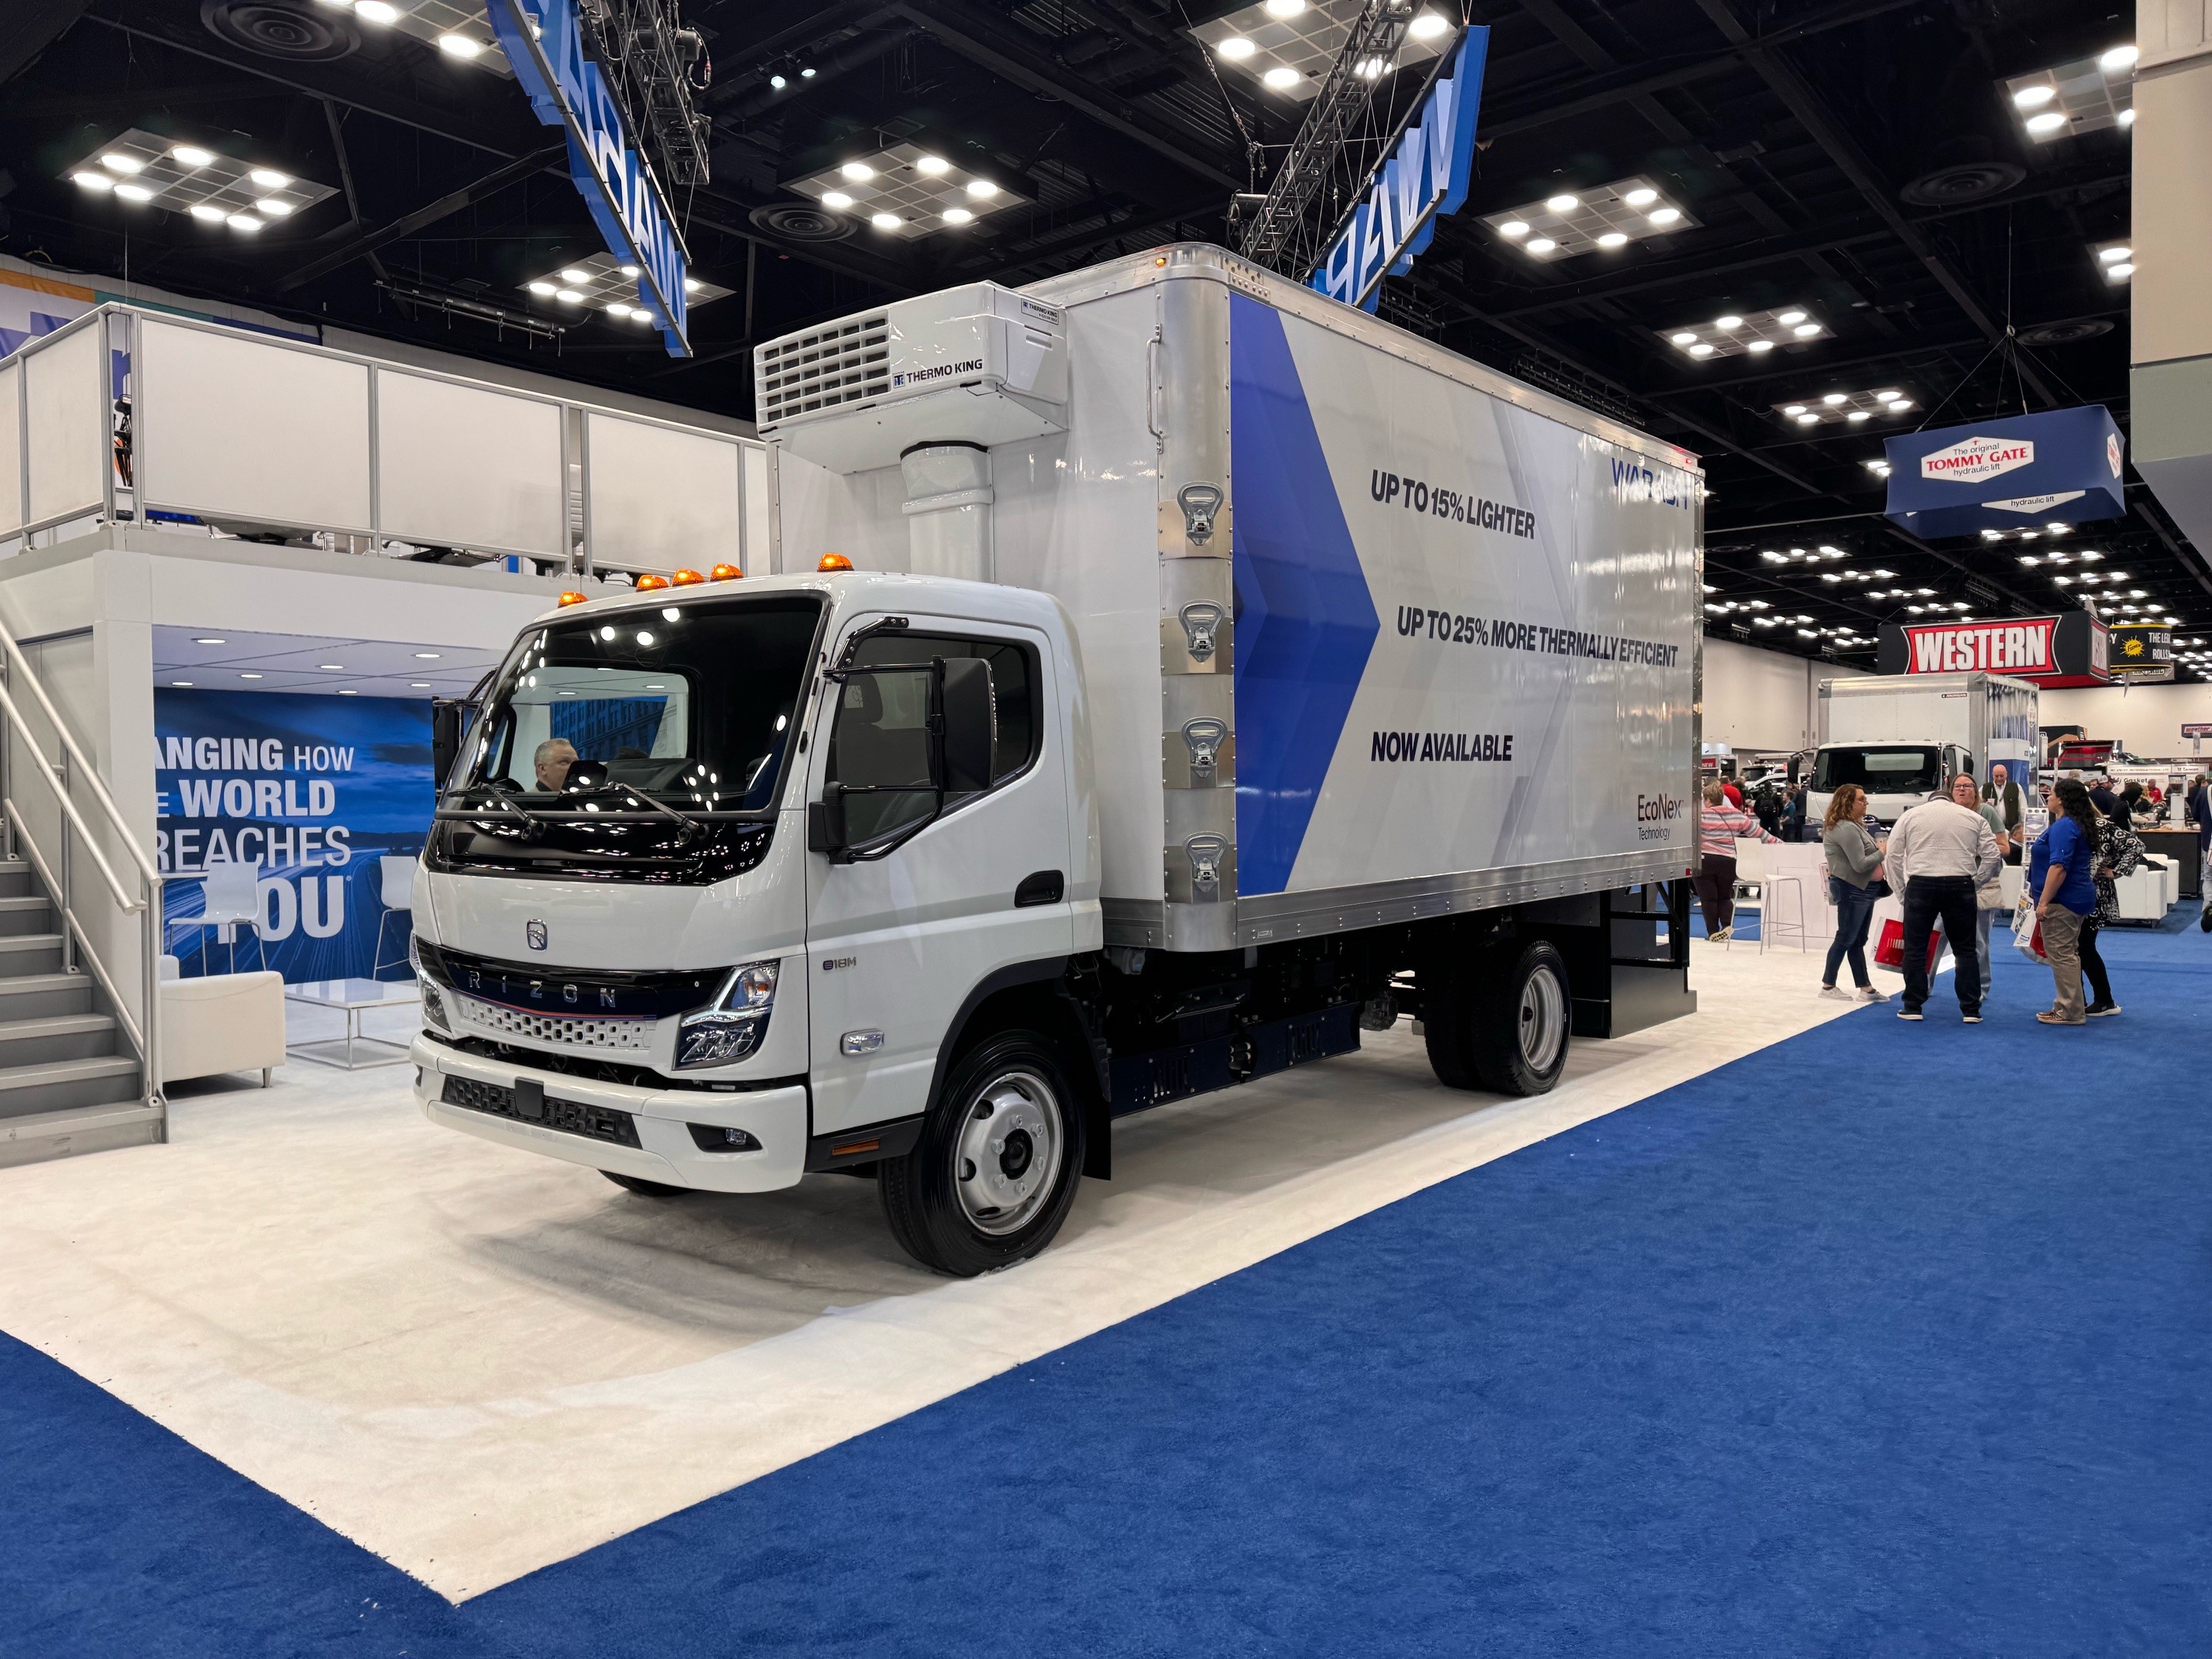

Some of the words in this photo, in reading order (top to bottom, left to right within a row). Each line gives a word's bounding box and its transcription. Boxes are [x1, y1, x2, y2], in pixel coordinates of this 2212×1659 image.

[1029, 303, 1046, 314] THERMO
[906, 365, 953, 383] THERMO
[955, 359, 983, 373] KING
[1927, 454, 1984, 472] TOMMY
[1990, 448, 2028, 462] GATE
[1970, 443, 2000, 453] original
[1953, 465, 1990, 476] hydraulic
[1372, 469, 1400, 503] UP
[1403, 477, 1428, 512] TO
[1431, 487, 1465, 522] 15%
[1467, 496, 1535, 539] LIGHTER
[2011, 496, 2045, 507] hydraulic
[1397, 605, 1424, 637] UP
[1427, 610, 1451, 641] TO
[1453, 615, 1488, 646] 25%
[1491, 620, 1537, 651] MORE
[1540, 627, 1618, 661] THERMALLY
[1619, 637, 1679, 668] EFFICIENT
[1915, 624, 2046, 672] WESTERN
[2148, 632, 2161, 644] THE
[294, 746, 355, 771] HOW
[1371, 731, 1420, 762] NOW
[1420, 733, 1513, 761] AVAILABLE
[178, 778, 335, 818] WORLD
[1638, 826, 1671, 840] Technology
[156, 826, 351, 871] REACHES
[200, 875, 344, 944] OU
[469, 970, 616, 1008] RIZON
